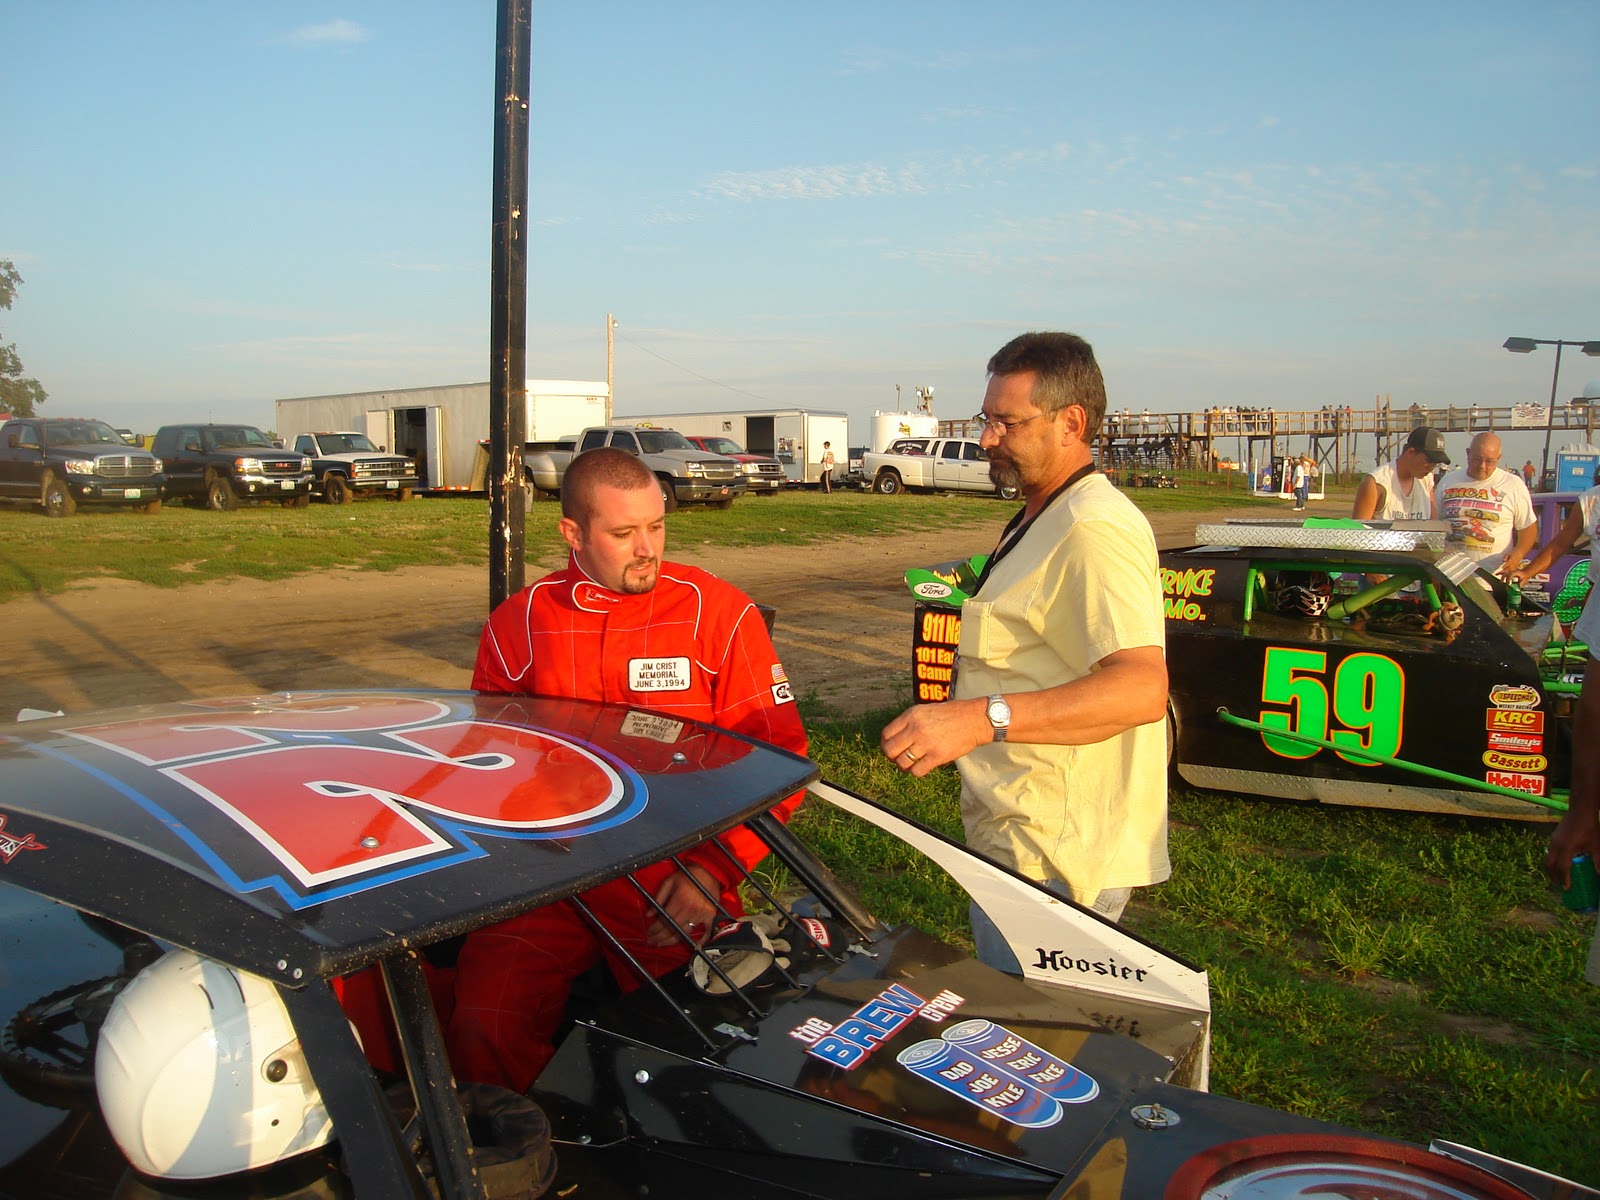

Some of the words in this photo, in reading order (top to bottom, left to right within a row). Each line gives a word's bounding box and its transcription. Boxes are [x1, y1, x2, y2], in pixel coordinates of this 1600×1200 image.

[921, 583, 946, 596] Ford
[1164, 598, 1206, 620] Mo.
[922, 612, 946, 642] 911
[915, 646, 937, 663] 101
[639, 670, 679, 679] MEMORIAL
[640, 662, 654, 671] JIM
[655, 661, 678, 670] CRIST
[634, 679, 655, 688] JUNE
[1259, 646, 1405, 767] 59
[1493, 711, 1536, 725] KRC
[1489, 753, 1541, 769] Bassett
[1487, 772, 1543, 795] Holley
[1032, 947, 1148, 983] Hoosier
[918, 989, 967, 1022] crew
[789, 1016, 834, 1043] the
[810, 983, 926, 1068] BREW
[981, 1036, 1022, 1059] JESSE
[939, 1061, 974, 1081] DAD
[1005, 1051, 1042, 1071] ERIC
[968, 1073, 999, 1093] JOE
[1027, 1063, 1066, 1083] FACE
[983, 1083, 1025, 1108] KYLE
